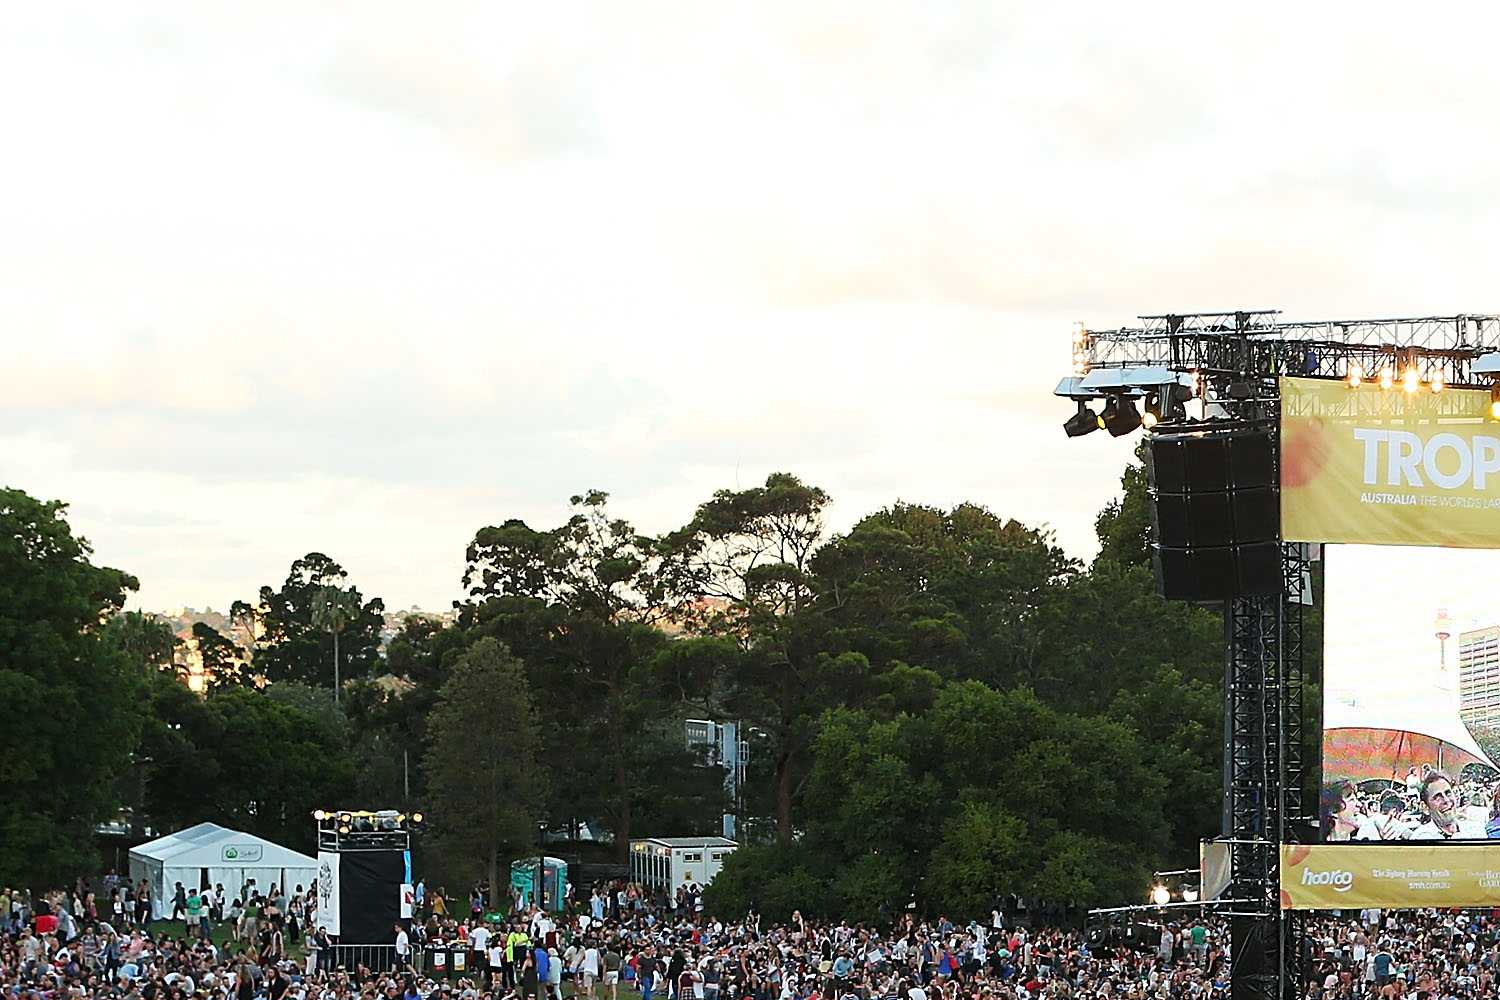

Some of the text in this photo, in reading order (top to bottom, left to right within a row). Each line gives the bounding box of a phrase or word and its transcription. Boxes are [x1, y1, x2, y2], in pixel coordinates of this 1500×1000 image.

[1360, 493, 1417, 505] AUSTRALIA
[1420, 495, 1437, 506] THE
[1301, 867, 1353, 885] hooroo
